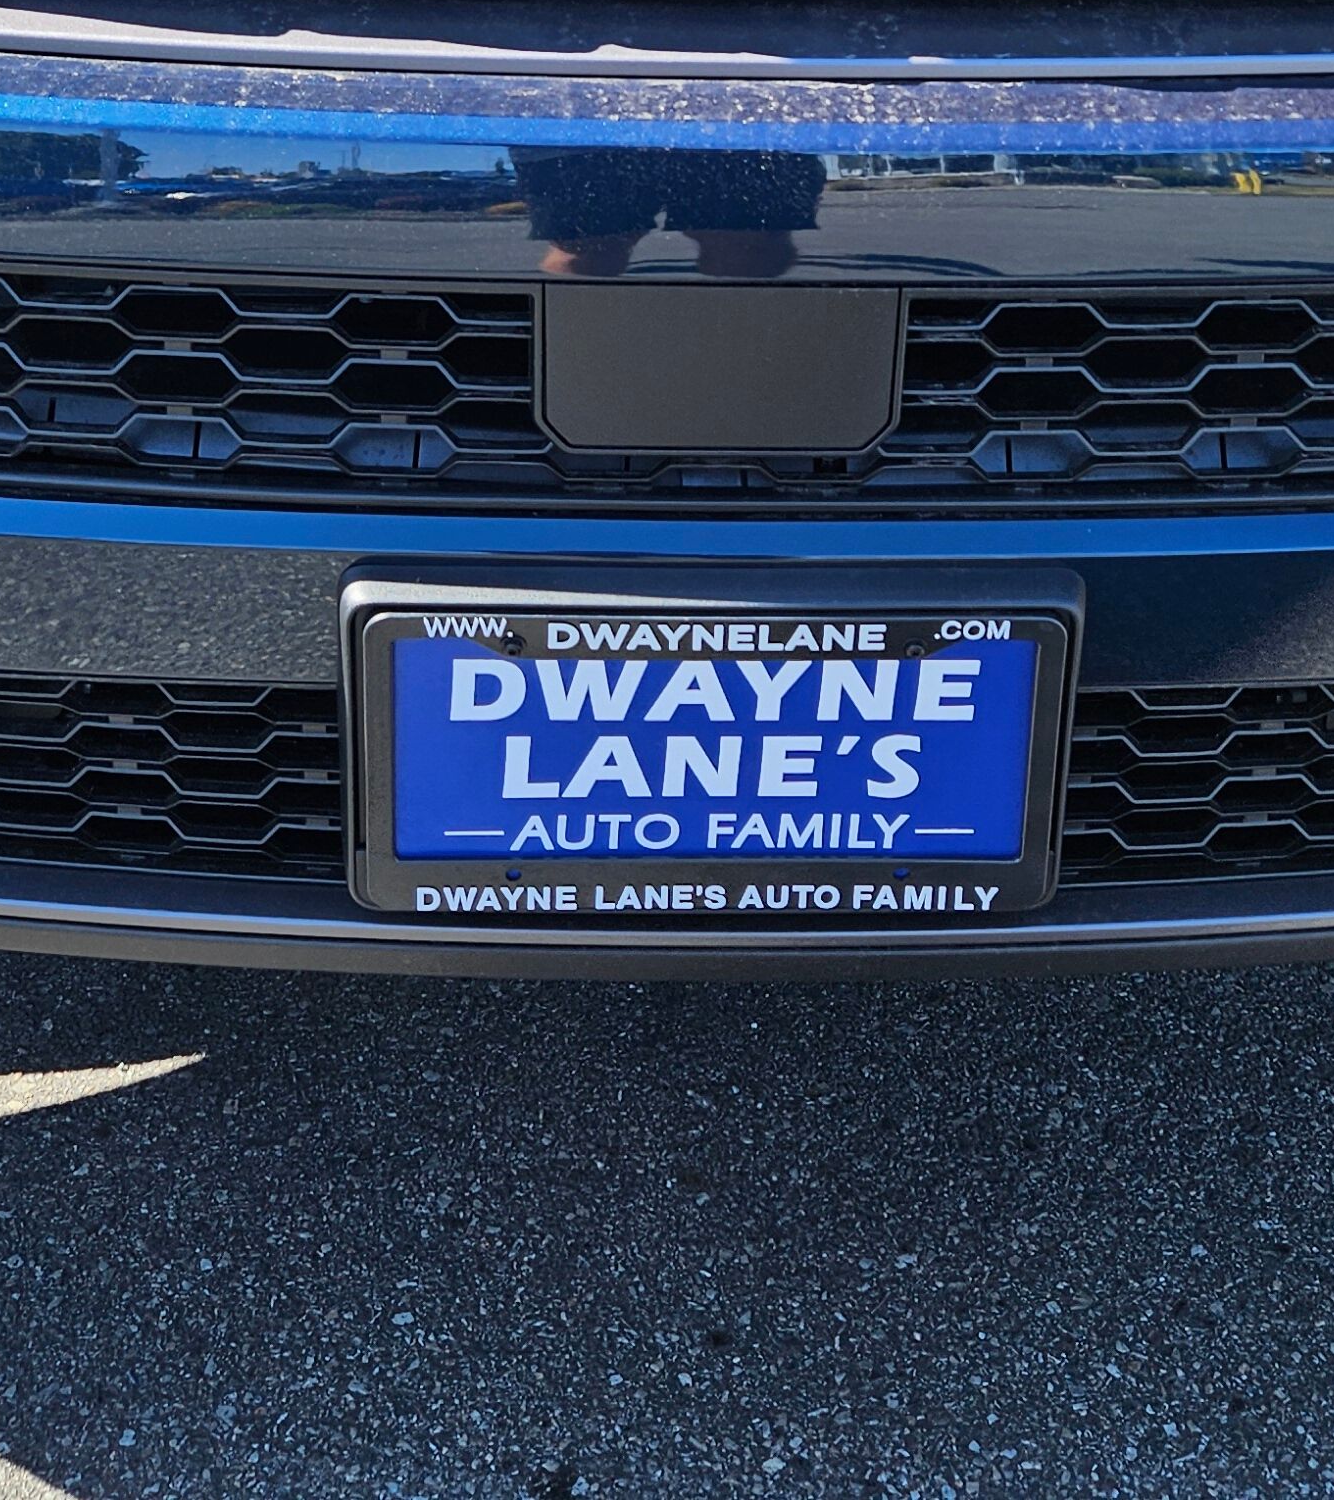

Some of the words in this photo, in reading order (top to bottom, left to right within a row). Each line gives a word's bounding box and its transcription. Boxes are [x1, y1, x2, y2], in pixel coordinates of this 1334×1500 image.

[422, 615, 515, 638] WWW.
[546, 621, 887, 652] DWAYNELANE
[932, 618, 1012, 641] .COM
[449, 658, 982, 722] DWAYNE
[501, 734, 923, 799] LANE'S
[509, 813, 681, 851] AUTO
[705, 812, 911, 850] FAMILY
[415, 885, 579, 913] DWAYNE
[593, 884, 728, 911] LANE'S
[736, 884, 841, 911] AUTO
[851, 884, 1001, 912] FAMILY
